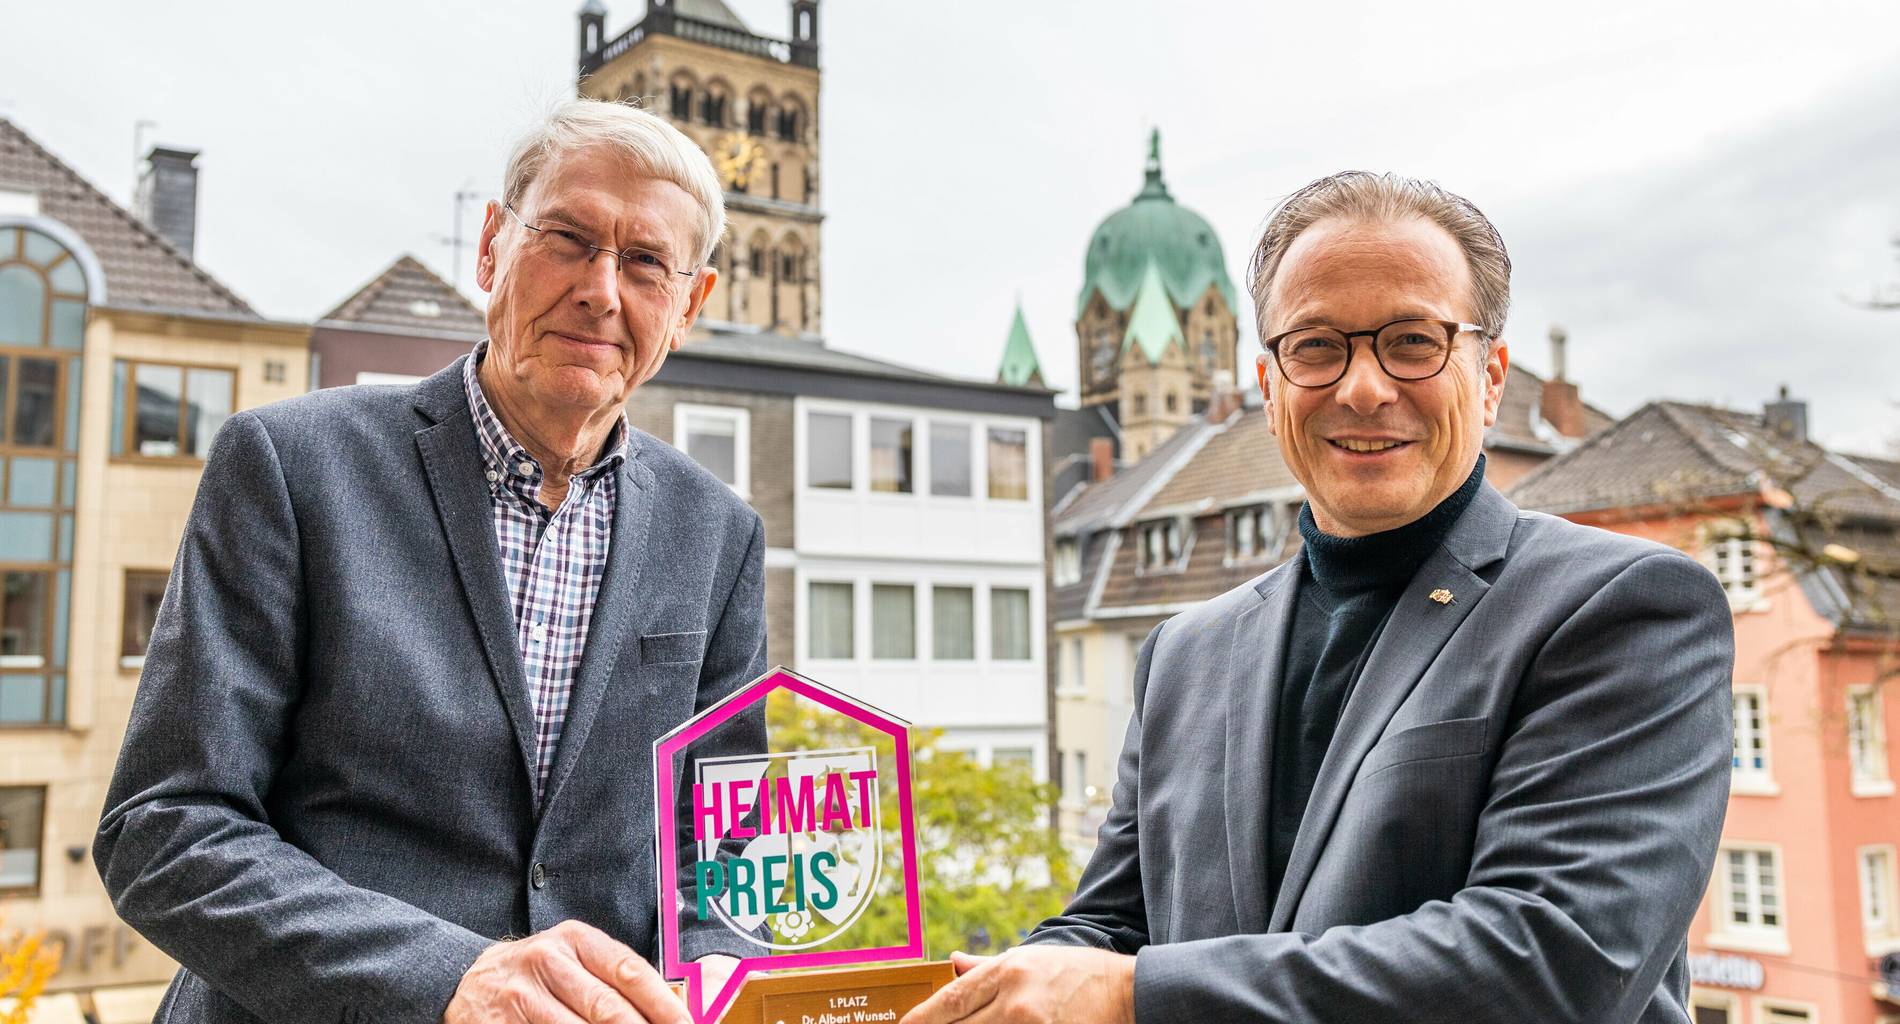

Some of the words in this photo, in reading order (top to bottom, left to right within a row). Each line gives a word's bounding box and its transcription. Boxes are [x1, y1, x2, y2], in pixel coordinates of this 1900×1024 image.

[693, 770, 877, 841] HEIMAT
[695, 851, 838, 920] PREIS
[819, 1013, 850, 1024] Albert
[853, 1009, 896, 1022] Wunsch
